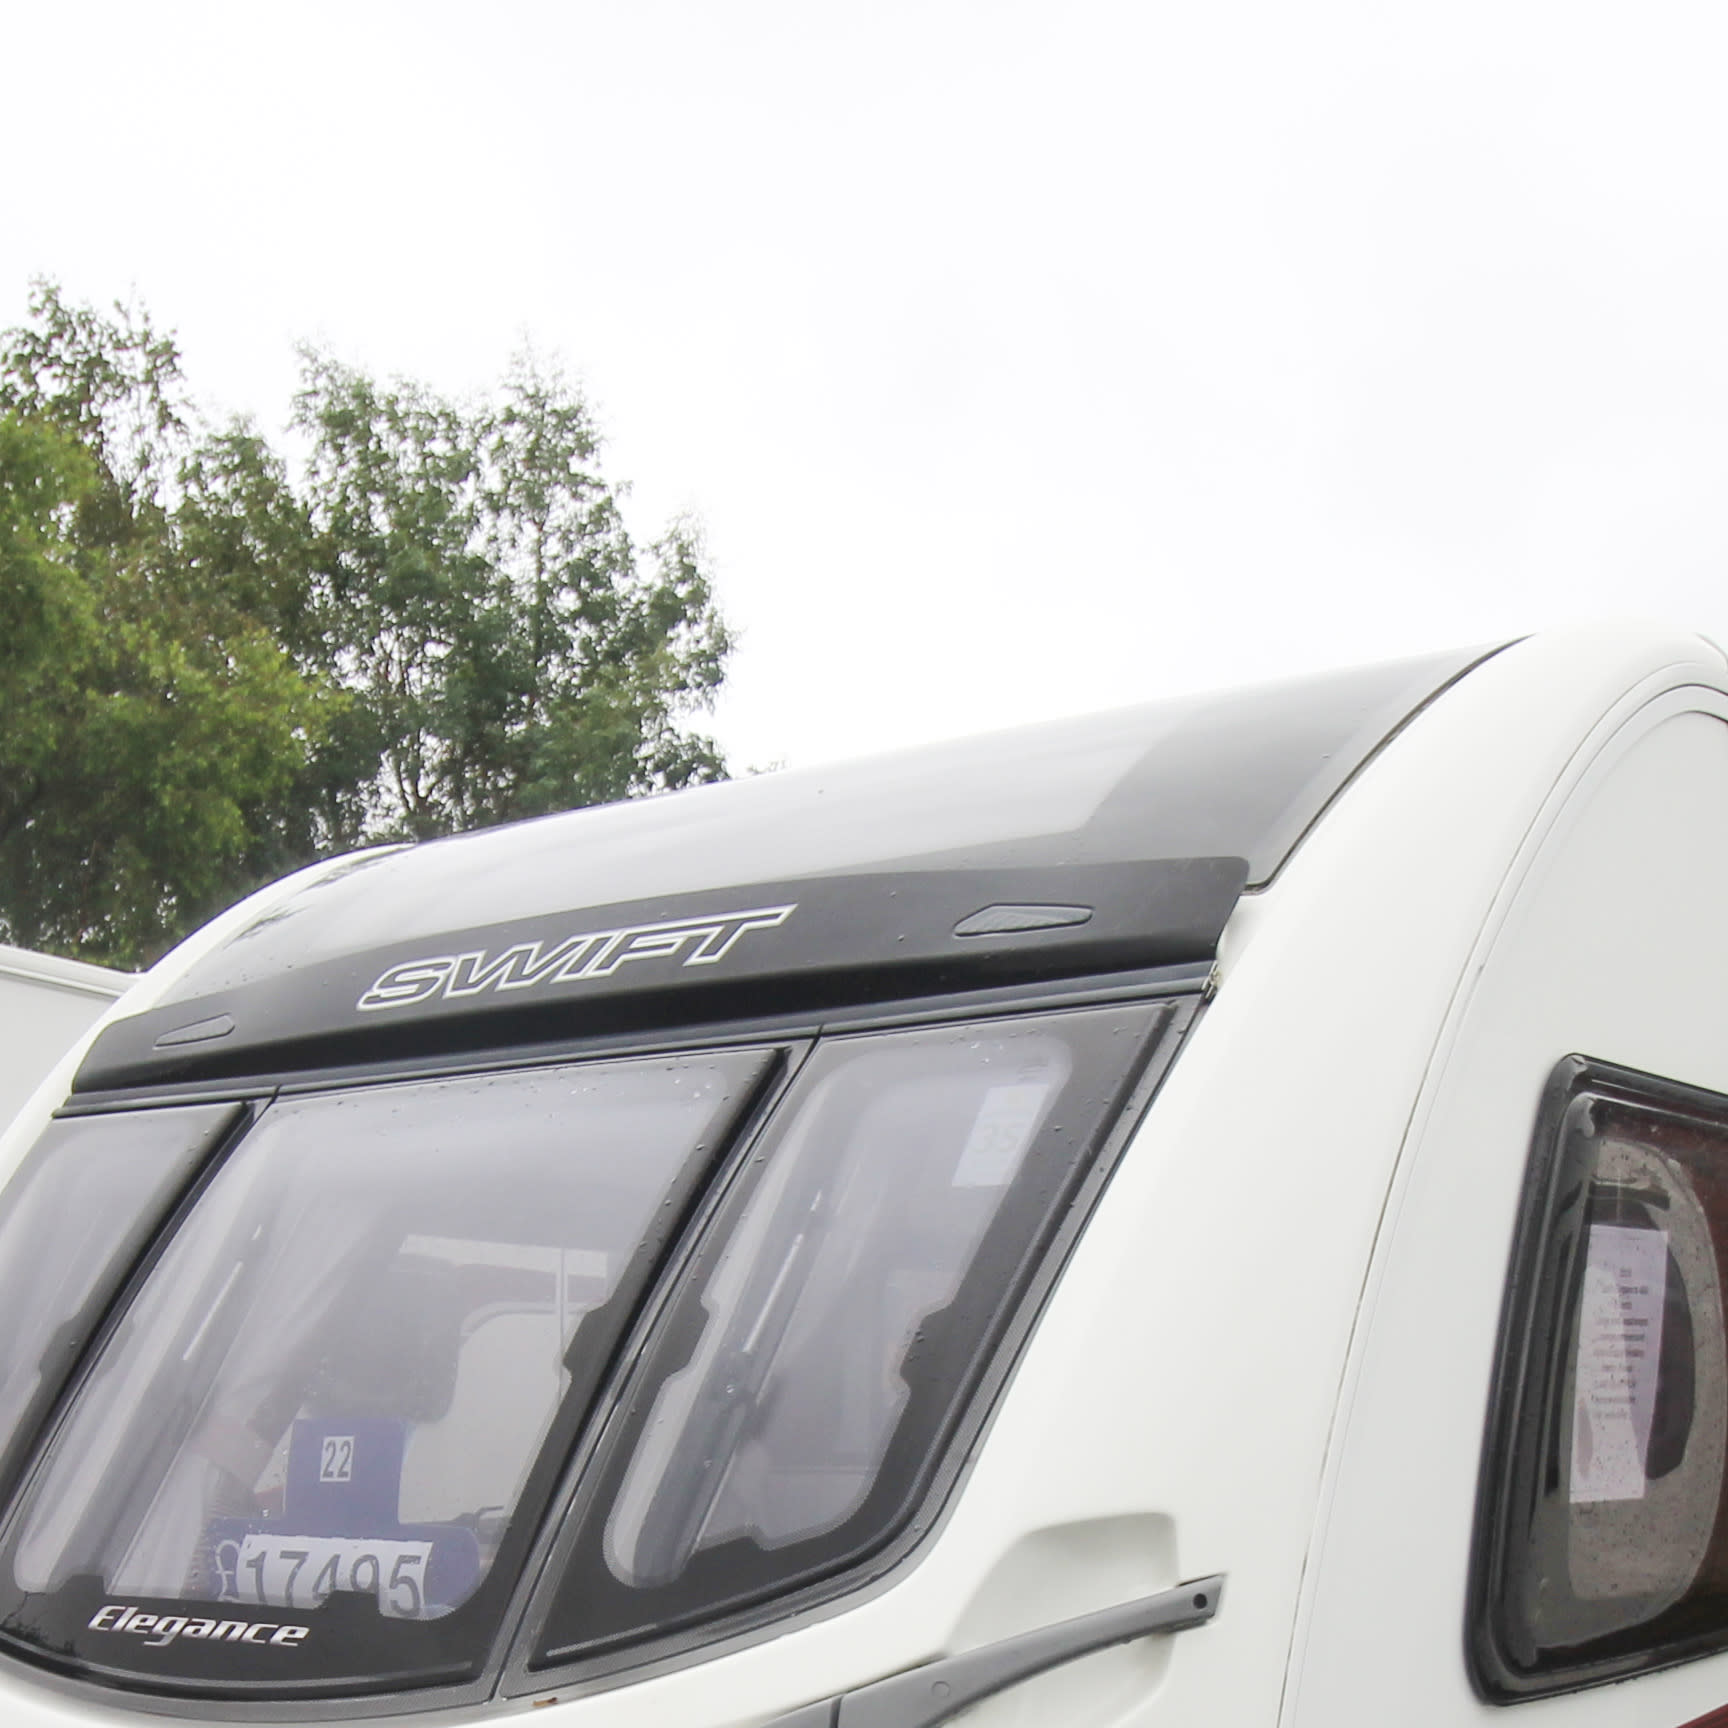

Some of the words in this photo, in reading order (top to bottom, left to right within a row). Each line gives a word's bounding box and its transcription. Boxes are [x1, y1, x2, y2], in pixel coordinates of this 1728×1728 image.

[357, 903, 798, 1011] SWIFT
[322, 1439, 352, 1479] 22
[87, 1605, 310, 1647] Elegance
